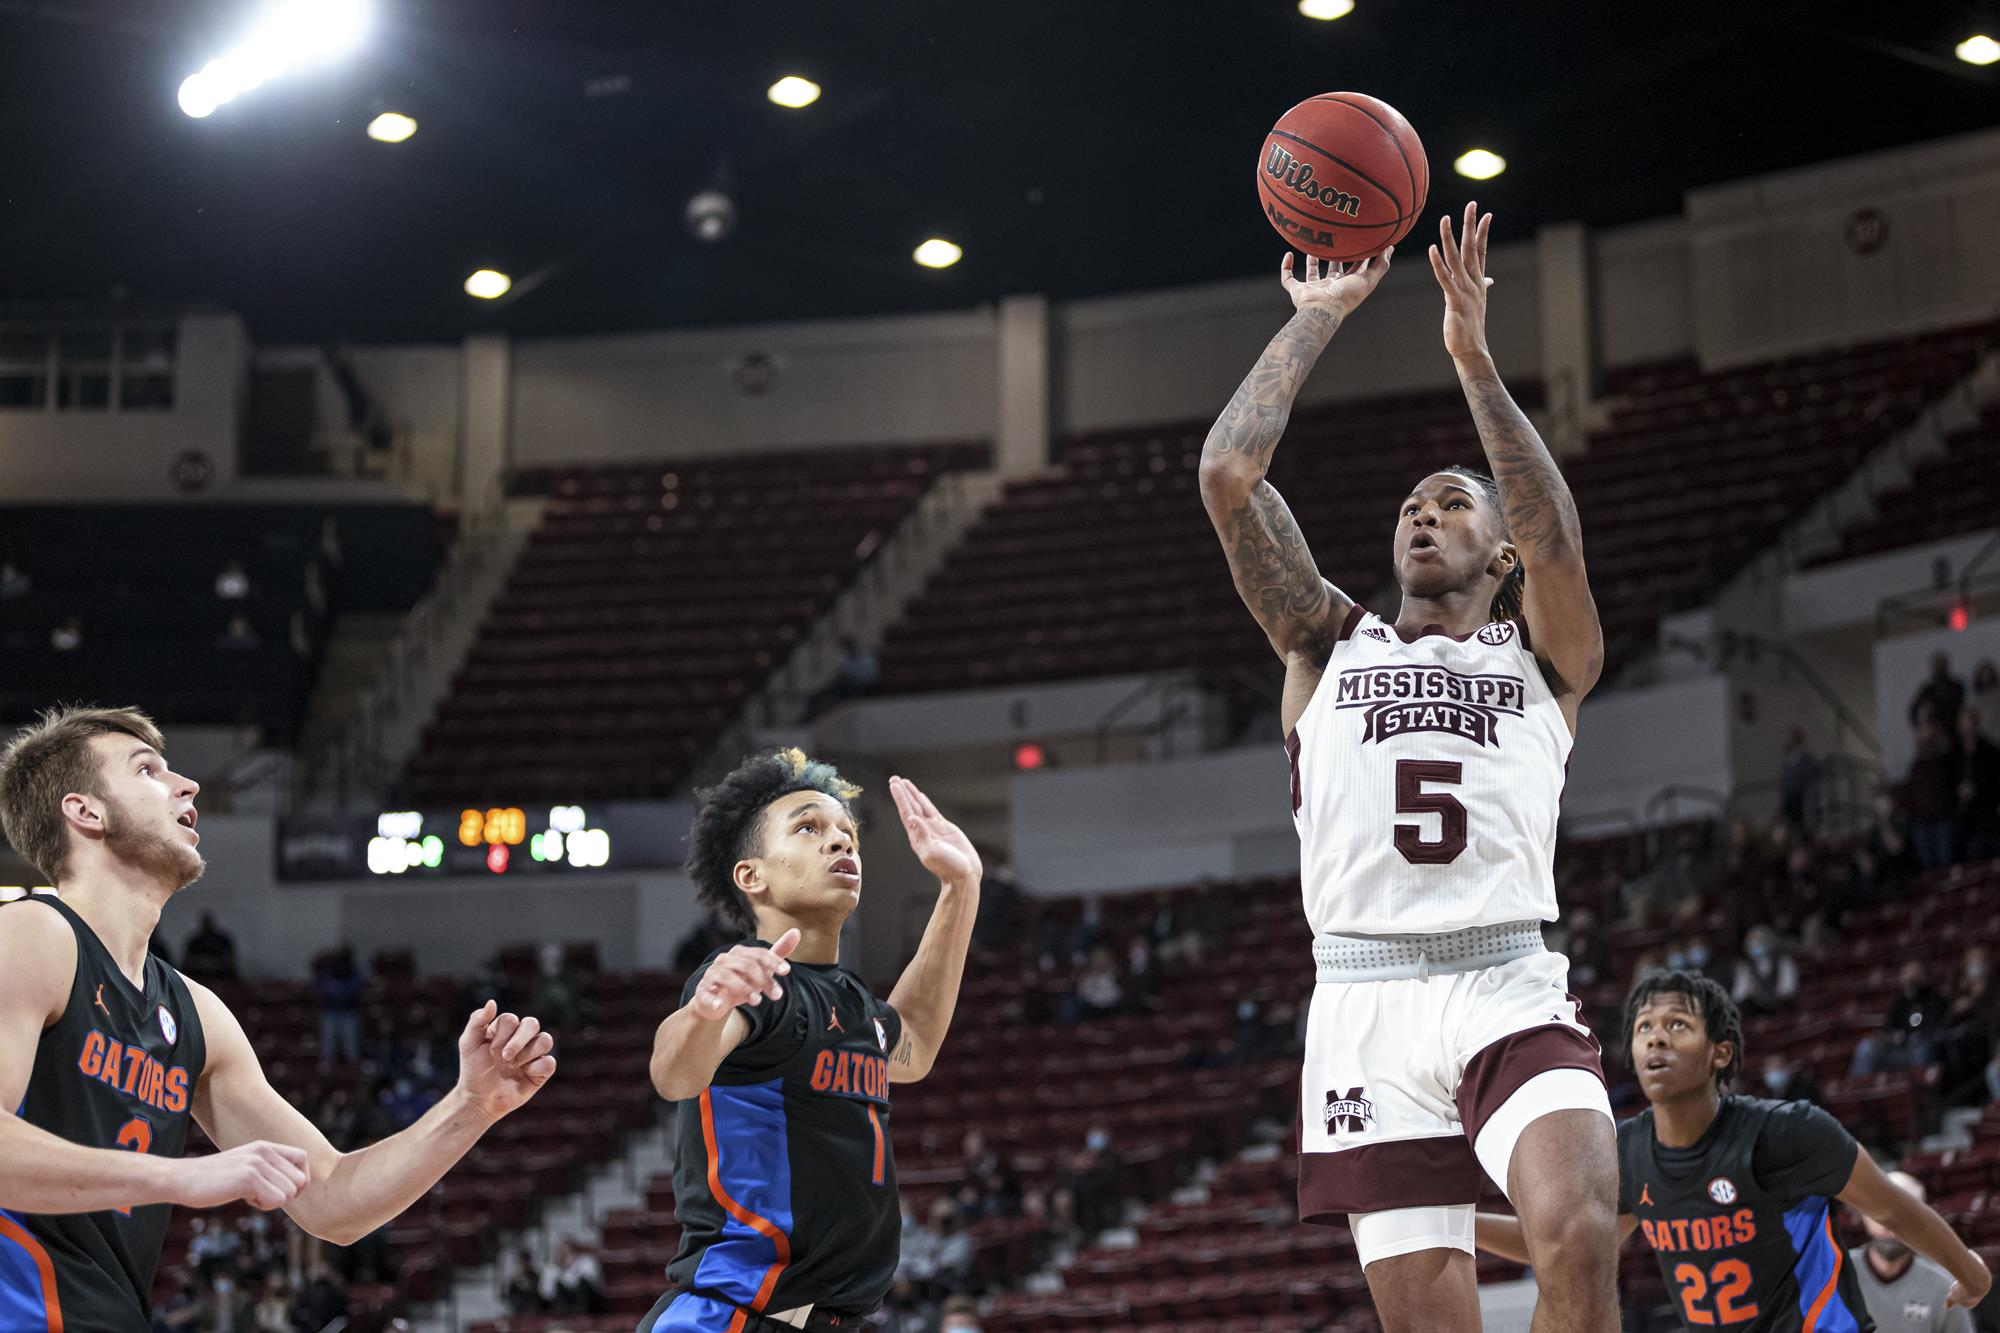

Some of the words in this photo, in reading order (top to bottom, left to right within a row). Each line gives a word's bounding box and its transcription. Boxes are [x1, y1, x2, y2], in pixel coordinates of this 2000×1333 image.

[1266, 142, 1361, 217] Wilson
[1268, 202, 1336, 248] NCAA
[1361, 629, 1391, 644] adidas
[1482, 623, 1513, 644] SEC
[1335, 670, 1524, 711] MISSISSIPPI
[1384, 706, 1476, 737] STATE
[1394, 759, 1467, 864] 5
[78, 1029, 188, 1113] GATORS
[810, 1050, 889, 1101] GATOR
[1327, 1102, 1361, 1118] STATE
[868, 1103, 885, 1186] 1
[1641, 1208, 1757, 1252] GATORS
[1674, 1258, 1759, 1326] 22
